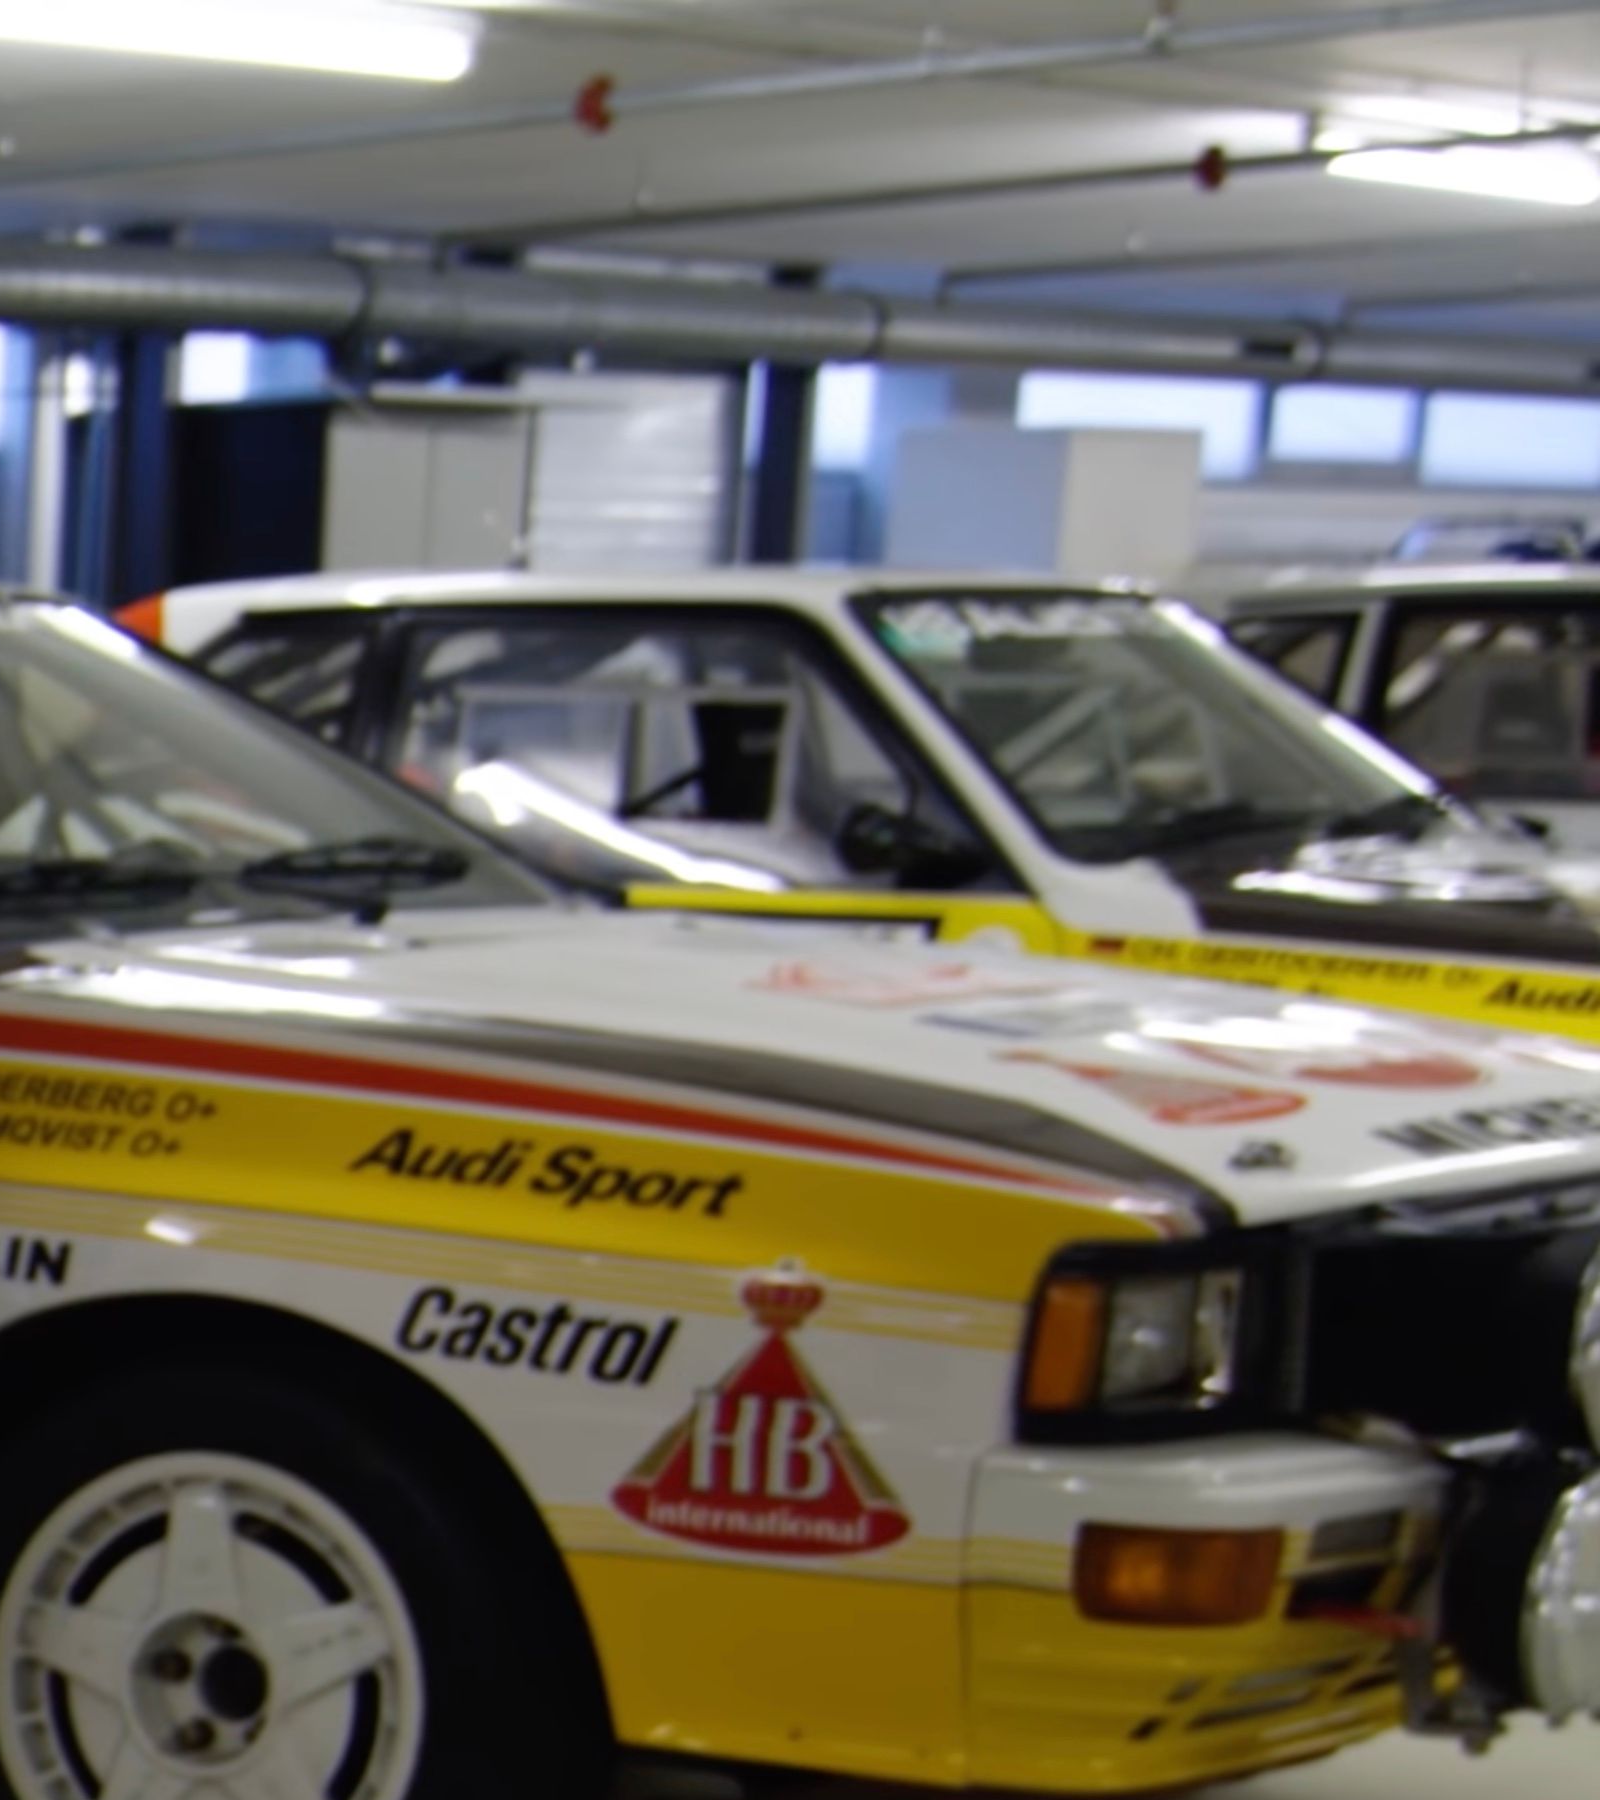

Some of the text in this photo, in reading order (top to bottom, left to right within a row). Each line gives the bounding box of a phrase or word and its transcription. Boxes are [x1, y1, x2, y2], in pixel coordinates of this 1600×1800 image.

[349, 1126, 745, 1219] Audi Sport
[393, 1285, 681, 1389] Castrol
[688, 1389, 838, 1501] HB
